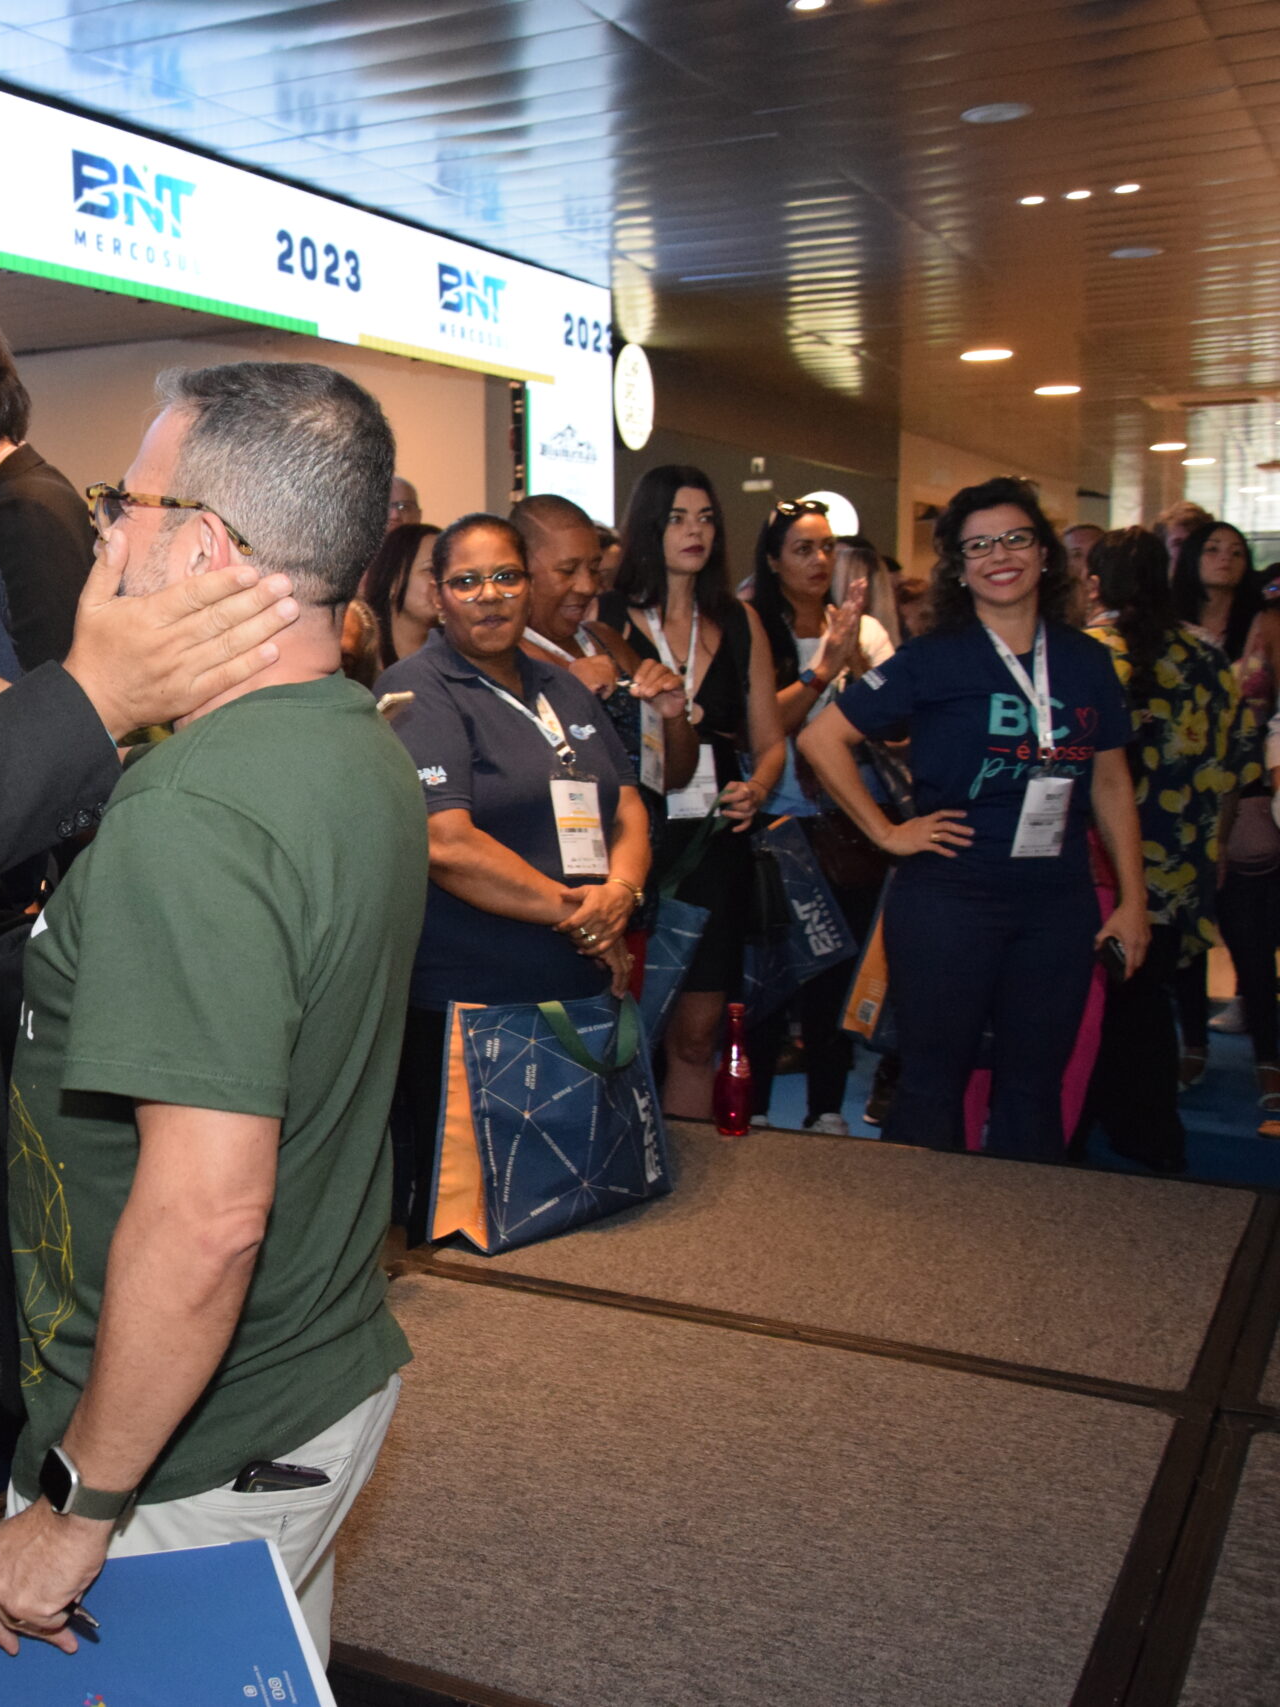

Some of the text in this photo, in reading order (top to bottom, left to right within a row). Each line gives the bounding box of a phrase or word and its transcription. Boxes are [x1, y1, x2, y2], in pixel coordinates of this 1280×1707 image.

[71, 148, 197, 239] BNT
[74, 228, 202, 275] MERCOSUL
[276, 229, 362, 292] 2023
[437, 261, 507, 324] BNT
[988, 692, 1071, 740] BC
[792, 897, 835, 957] BNT
